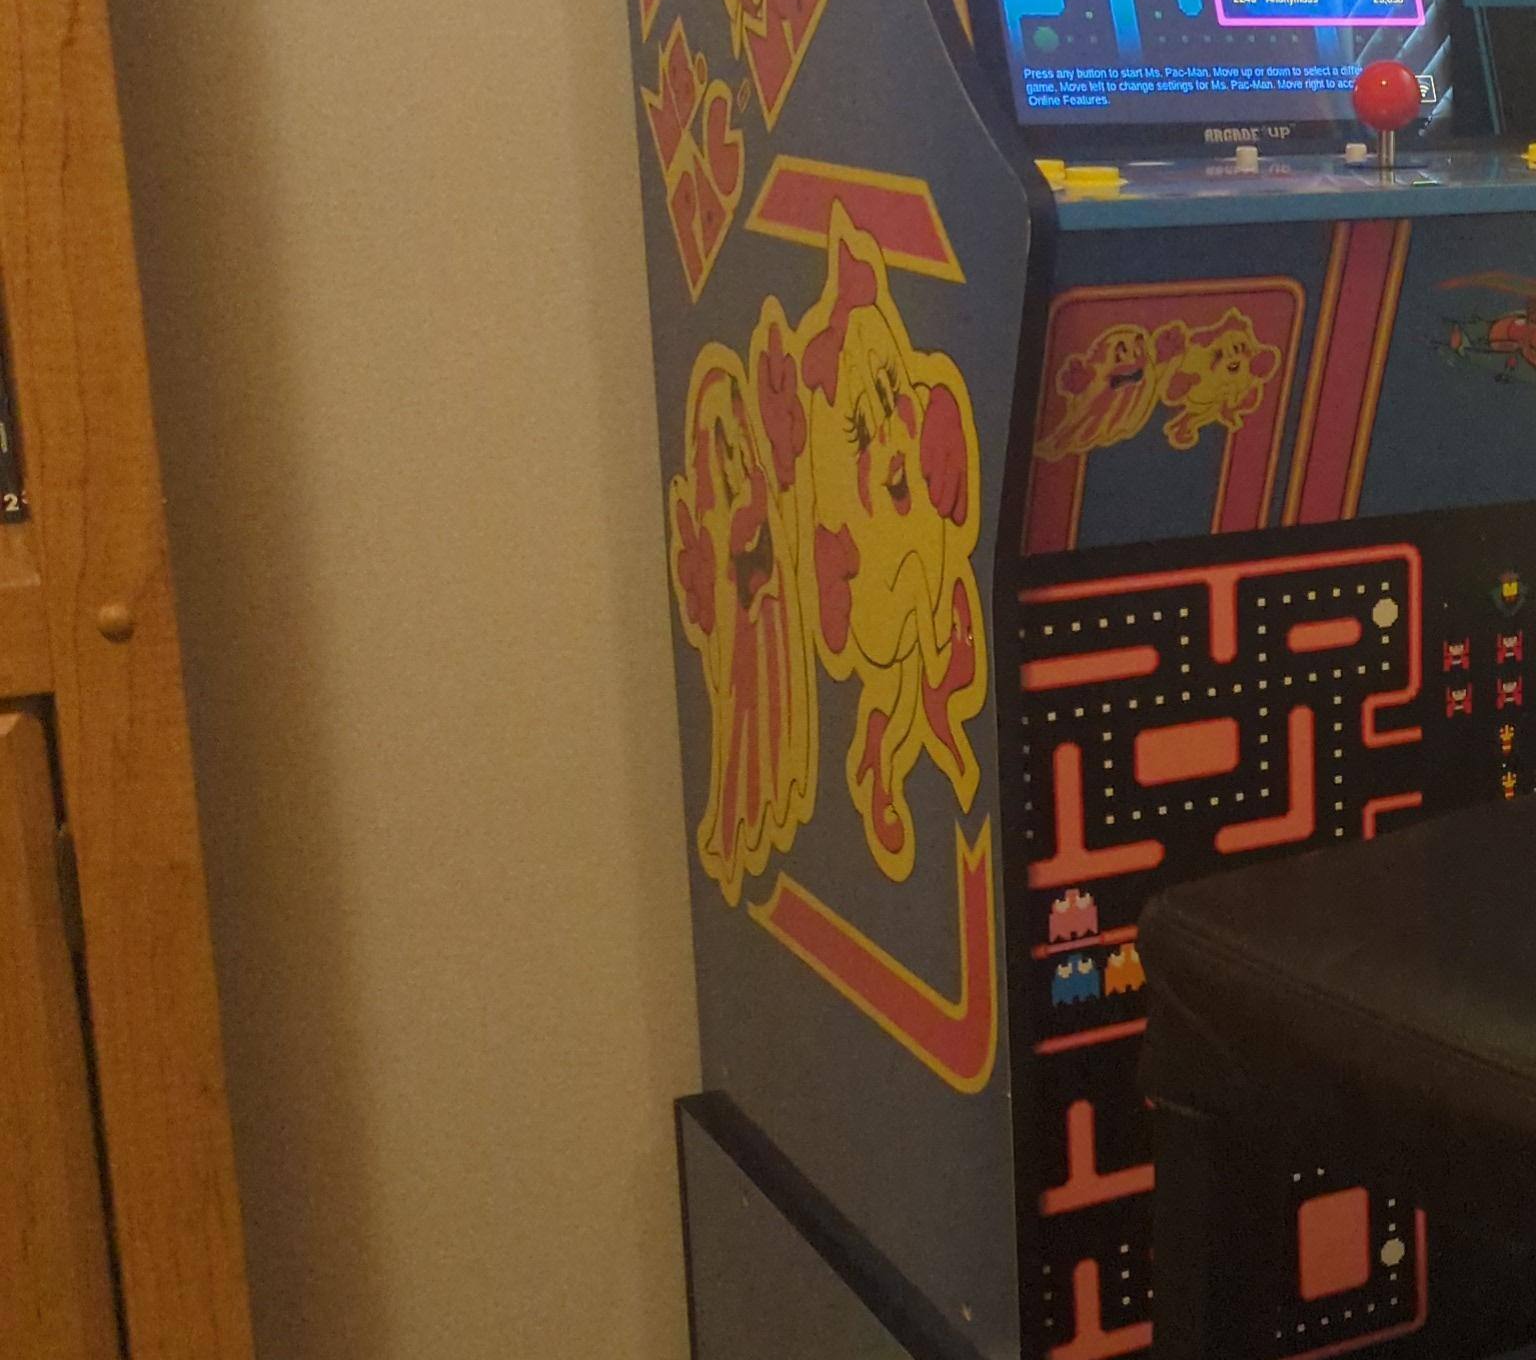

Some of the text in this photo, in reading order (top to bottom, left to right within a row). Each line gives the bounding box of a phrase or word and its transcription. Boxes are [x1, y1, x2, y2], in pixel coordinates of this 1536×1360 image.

[1023, 65, 1363, 81] Press any button to start Ms. Pac-Man. Move up or down to select a diffe
[1026, 79, 1354, 95] game. Move left to change settings for Ms. Pac-Man. Move right to acc
[1029, 94, 1110, 106] Online Features.
[1204, 126, 1290, 143] ARCADEUP
